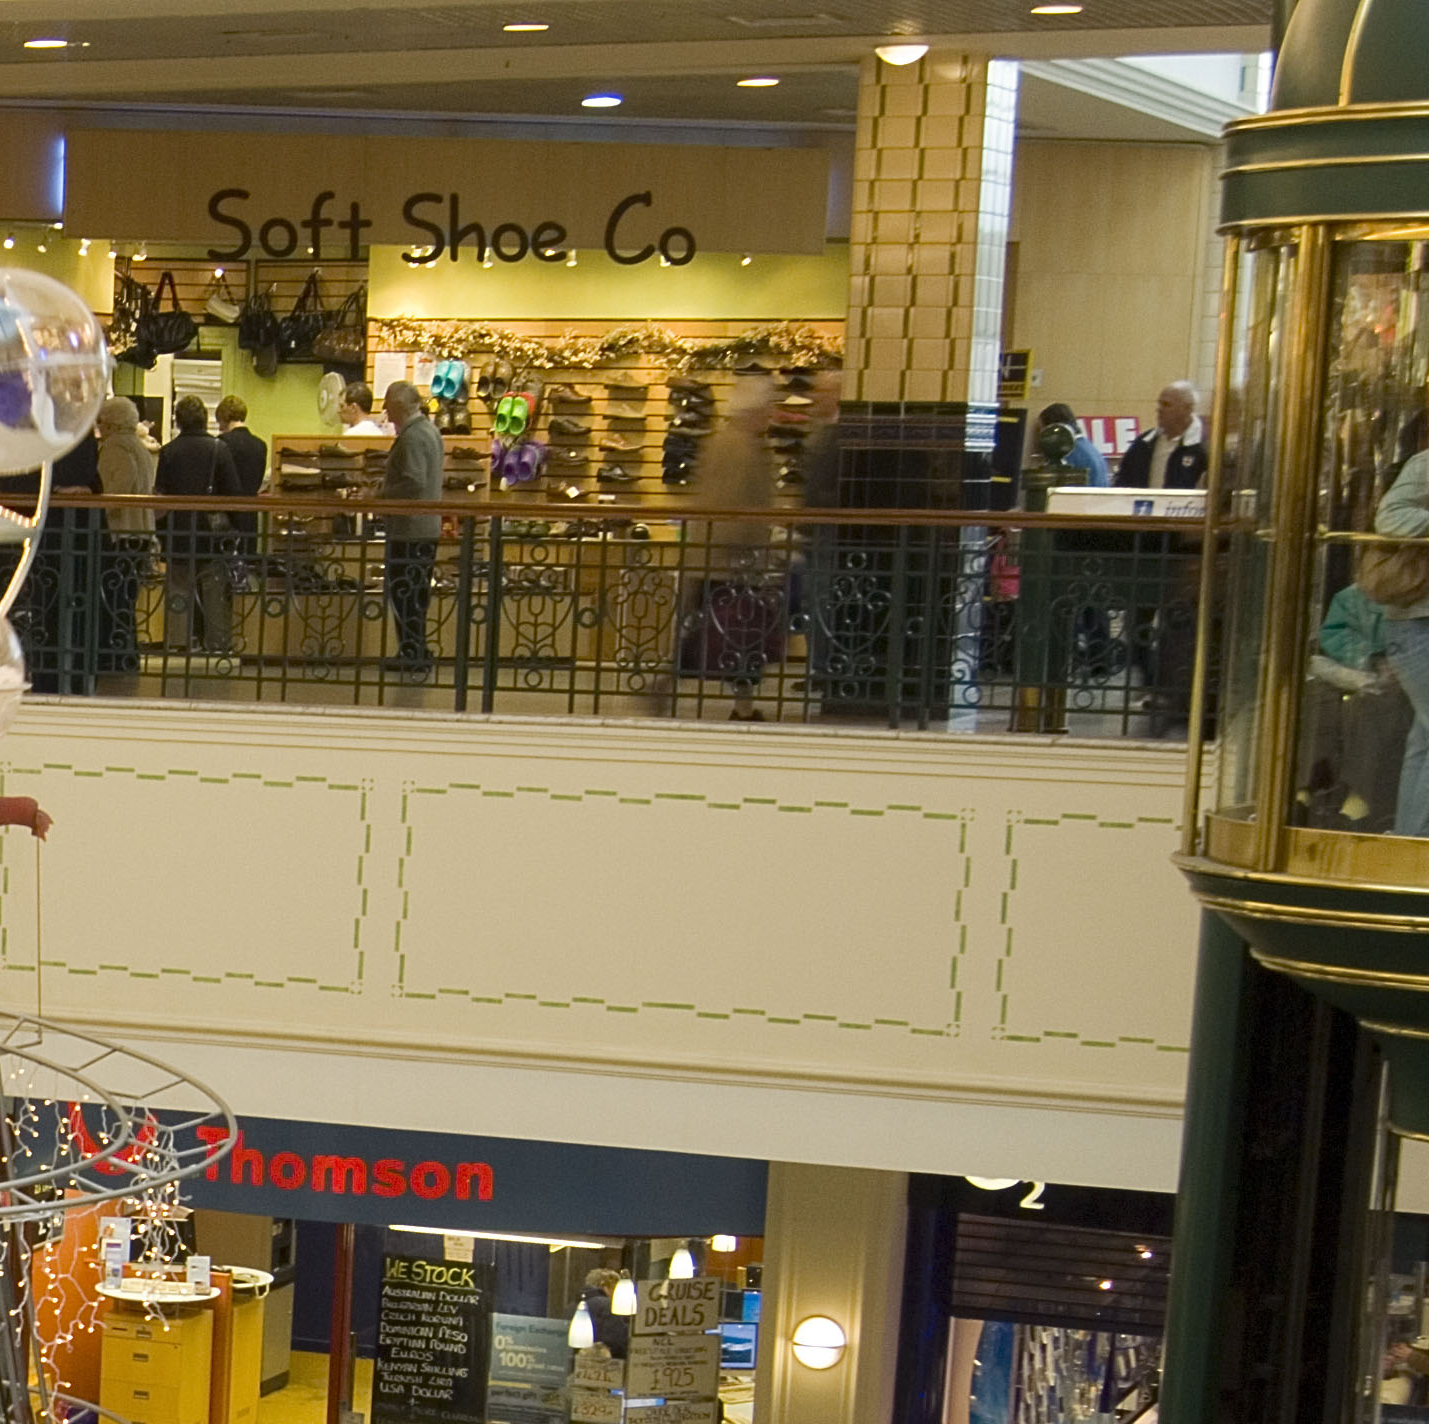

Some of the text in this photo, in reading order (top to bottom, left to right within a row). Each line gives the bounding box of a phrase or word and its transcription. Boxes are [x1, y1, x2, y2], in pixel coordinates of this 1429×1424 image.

[207, 188, 696, 267] Soft Shoe Co
[195, 1125, 495, 1201] Thomson
[386, 1257, 475, 1288] WE STOCK
[439, 1290, 479, 1305] DOLLAR
[648, 1281, 715, 1301] CRUISE
[644, 1303, 705, 1328] DEALS
[438, 1326, 468, 1342] PESO
[391, 1347, 433, 1361] EUROS
[430, 1340, 467, 1355] POUND
[379, 1382, 454, 1400] USA DOLLAR
